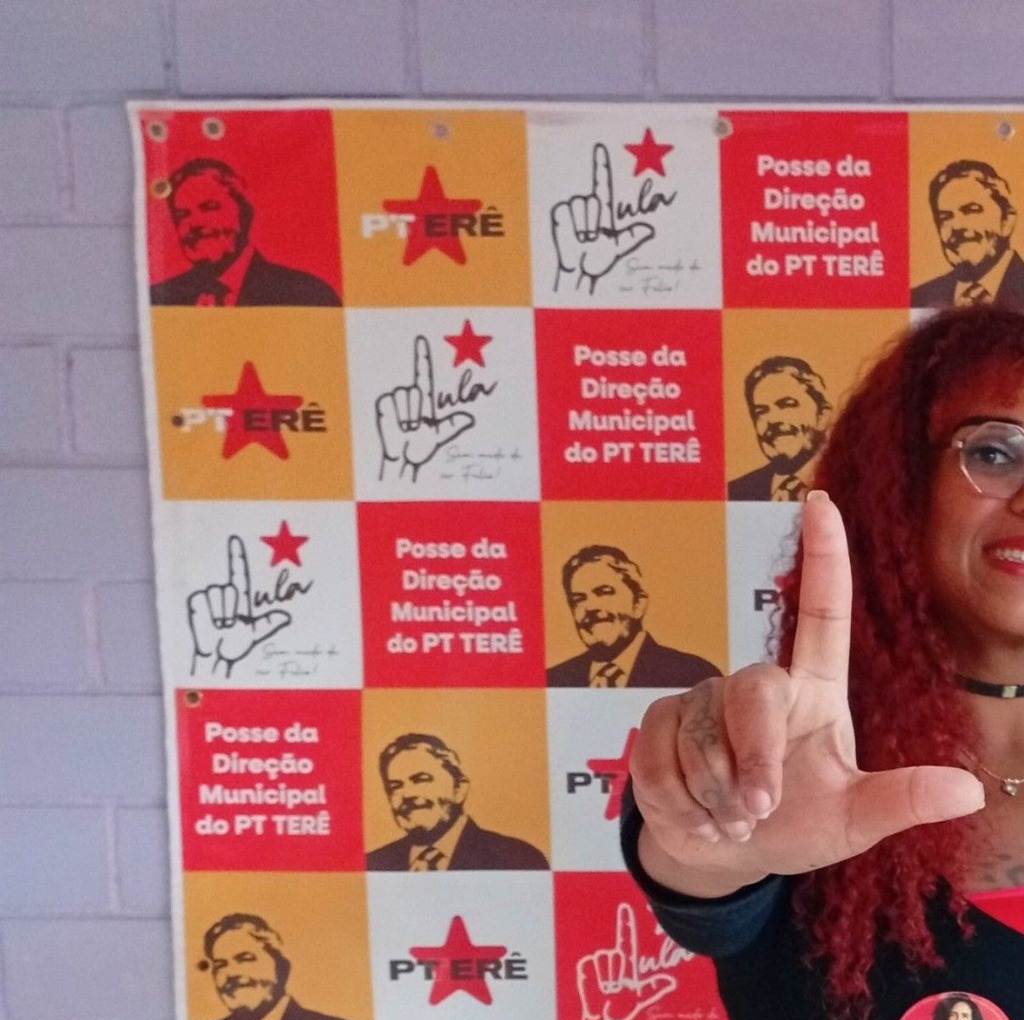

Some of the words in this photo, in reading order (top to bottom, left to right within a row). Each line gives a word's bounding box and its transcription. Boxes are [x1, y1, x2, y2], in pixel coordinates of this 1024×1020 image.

[757, 154, 832, 177] Posse
[835, 154, 872, 177] da
[763, 186, 865, 217] Direção
[751, 219, 880, 249] Municipal
[745, 253, 781, 277] do
[785, 254, 818, 277] PT
[821, 249, 885, 277] TERÊ
[573, 344, 647, 367] Posse
[651, 344, 687, 367] da
[581, 376, 681, 406] Direção
[568, 408, 696, 437] Municipal
[563, 441, 599, 463] do
[602, 441, 635, 463] PT
[639, 436, 701, 463] TERÊ
[395, 537, 467, 559] Posse
[470, 537, 508, 559] da
[402, 568, 503, 597] Direção
[391, 599, 518, 627] Municipal
[386, 632, 419, 654] do
[421, 632, 455, 653] PT
[459, 627, 523, 654] TERÊ
[205, 721, 280, 743] Posse
[283, 721, 319, 743] da
[212, 751, 315, 781] Direção
[199, 783, 327, 809] Municipal
[195, 814, 230, 835] do
[234, 814, 268, 835] PT
[271, 809, 331, 836] TERÊ
